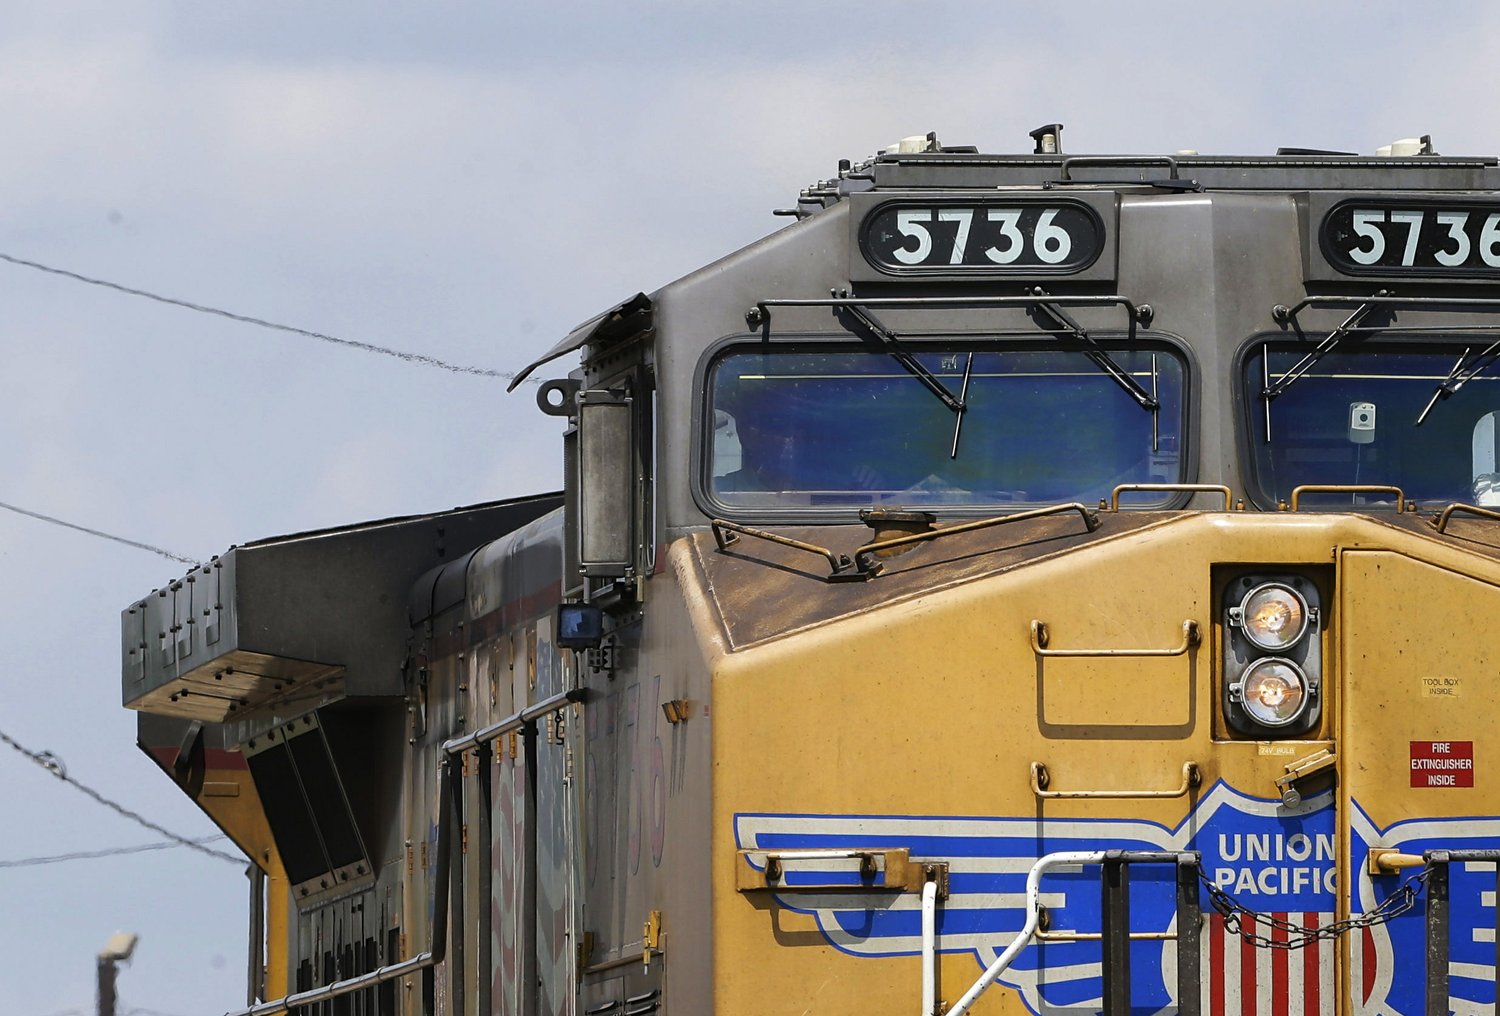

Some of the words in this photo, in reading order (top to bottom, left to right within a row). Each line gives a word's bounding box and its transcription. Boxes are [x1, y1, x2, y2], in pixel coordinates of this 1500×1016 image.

[893, 209, 1071, 264] 5736
[1432, 743, 1450, 753] FIRE
[1411, 759, 1472, 769] EXTINGUISHER
[1428, 775, 1456, 785] INSIDE
[1219, 833, 1336, 861] UNION
[1215, 867, 1337, 895] PACIFIC
